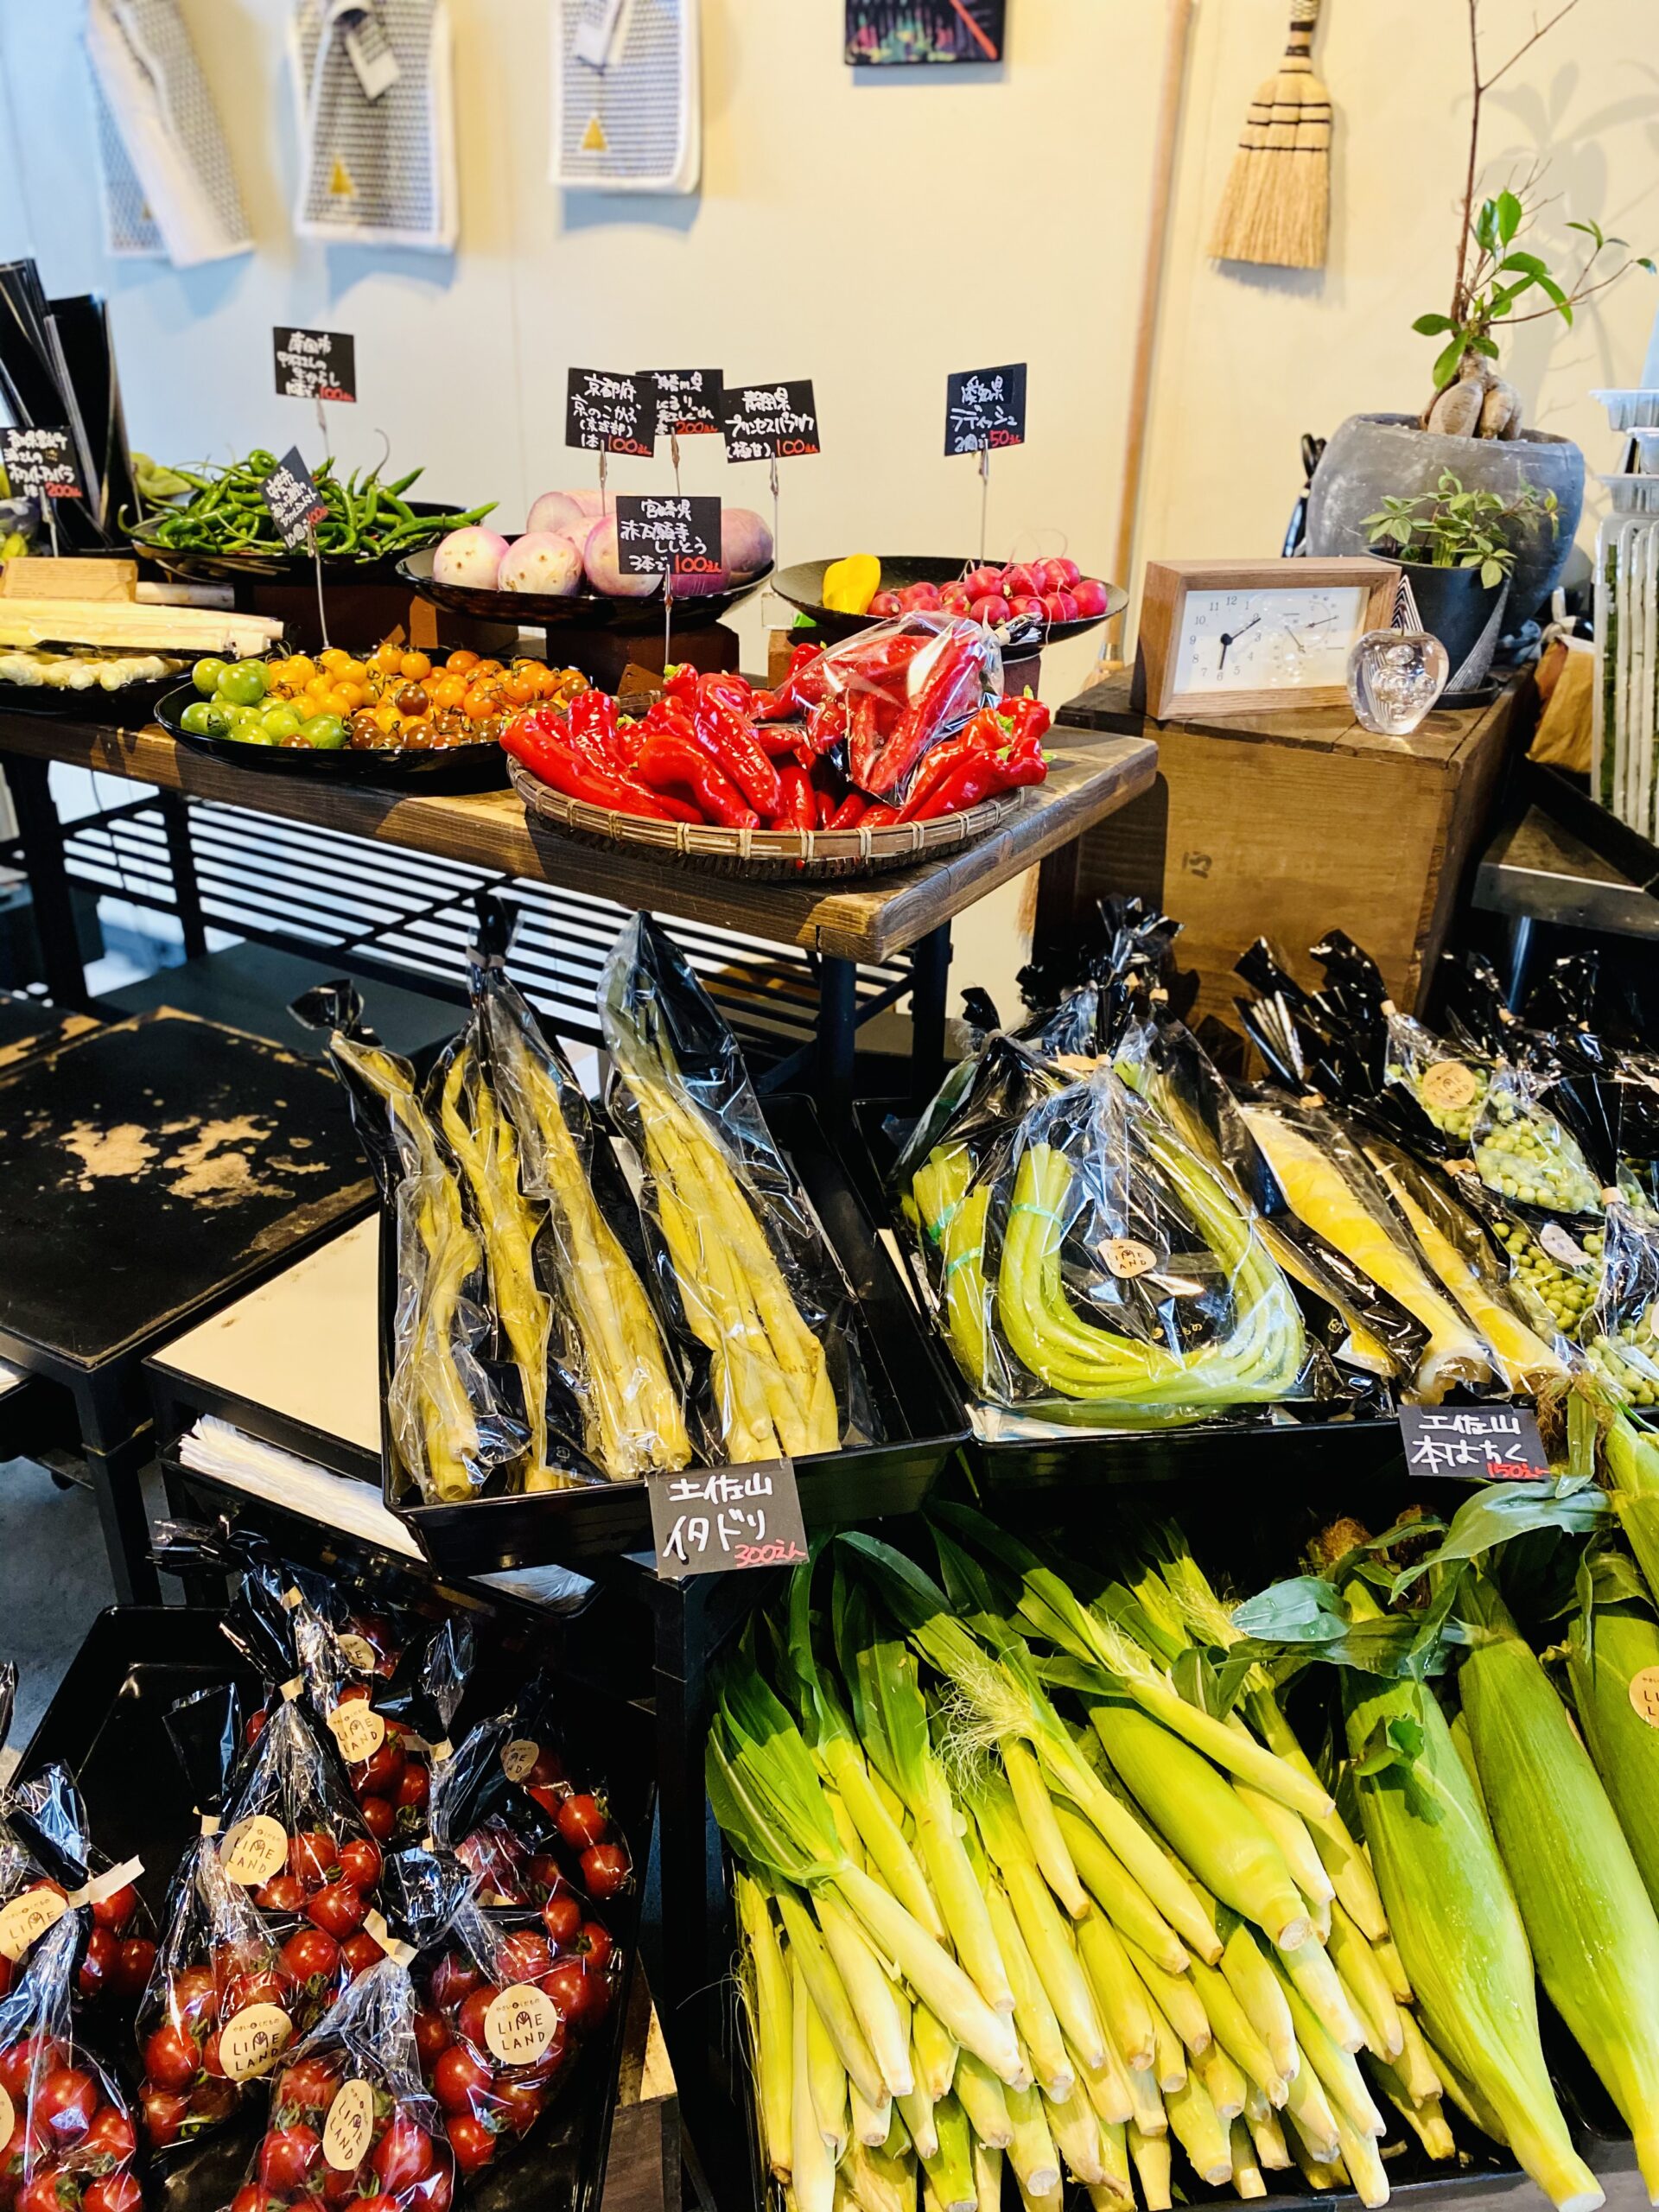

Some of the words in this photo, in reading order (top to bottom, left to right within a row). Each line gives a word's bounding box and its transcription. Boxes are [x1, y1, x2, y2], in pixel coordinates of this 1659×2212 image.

[584, 373, 637, 403] 京都府
[741, 387, 791, 413] 静岡県
[641, 499, 692, 522] 宮崎県
[655, 536, 707, 554] ししとう
[629, 555, 668, 572] 3本で
[675, 554, 722, 574] 100えん
[1210, 602, 1219, 612] 11
[1226, 596, 1237, 606] 12
[1195, 616, 1206, 626] 10
[1189, 636, 1197, 645] 9
[1255, 632, 1262, 642] 3
[1192, 655, 1199, 664] 8
[1233, 665, 1241, 675] 5
[1200, 668, 1208, 677] 7
[1217, 672, 1223, 682] 6
[1107, 1249, 1144, 1261] LIME
[1410, 1435, 1528, 1474] 本はちく
[669, 1472, 773, 1505] 土佐山
[662, 1509, 766, 1560] イタドリ
[734, 1539, 807, 1567] 300えん
[337, 1718, 373, 1742] LIME
[344, 1731, 378, 1753] LAND
[234, 1837, 275, 1859] LIME
[229, 1853, 267, 1874] LAND
[10, 1910, 54, 1939] LIME
[498, 2012, 543, 2035] LIME
[233, 2031, 280, 2056] LIME
[502, 2031, 545, 2050] LAND
[236, 2048, 278, 2071] LAND
[338, 2100, 363, 2146] LIME
[330, 2117, 353, 2160] LAND
